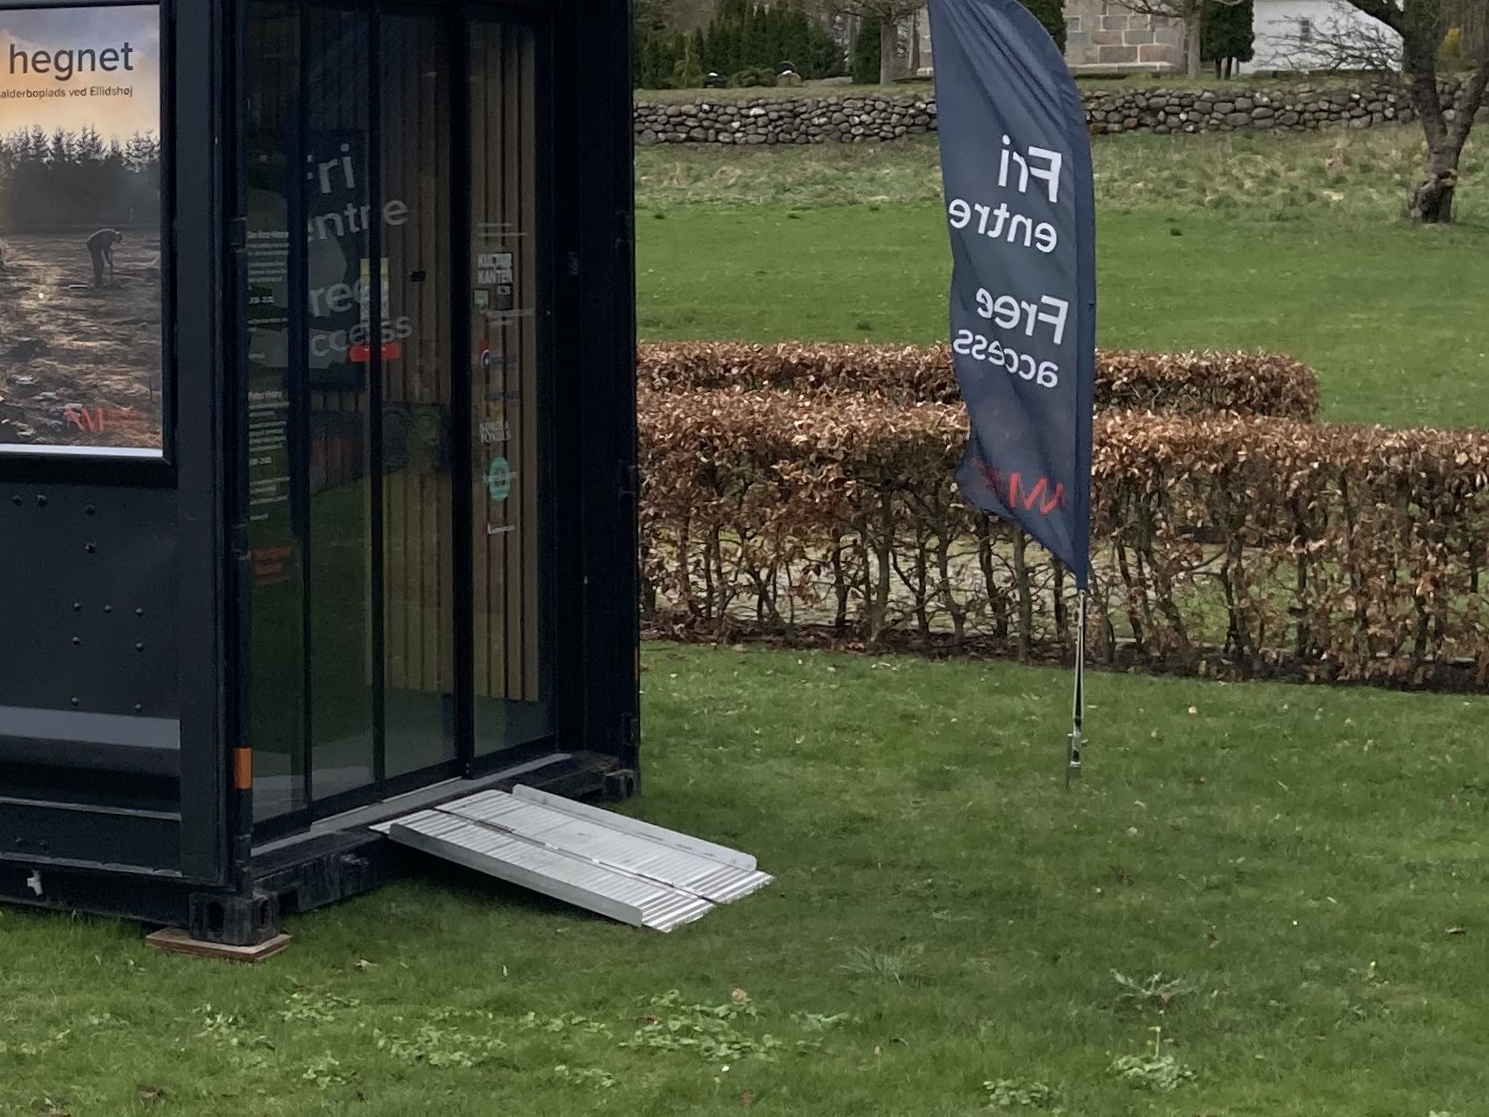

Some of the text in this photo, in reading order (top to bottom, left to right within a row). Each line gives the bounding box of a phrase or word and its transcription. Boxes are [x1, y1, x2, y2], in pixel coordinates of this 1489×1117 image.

[10, 42, 134, 81] hegnet
[69, 86, 87, 97] ved
[307, 143, 355, 194] ri
